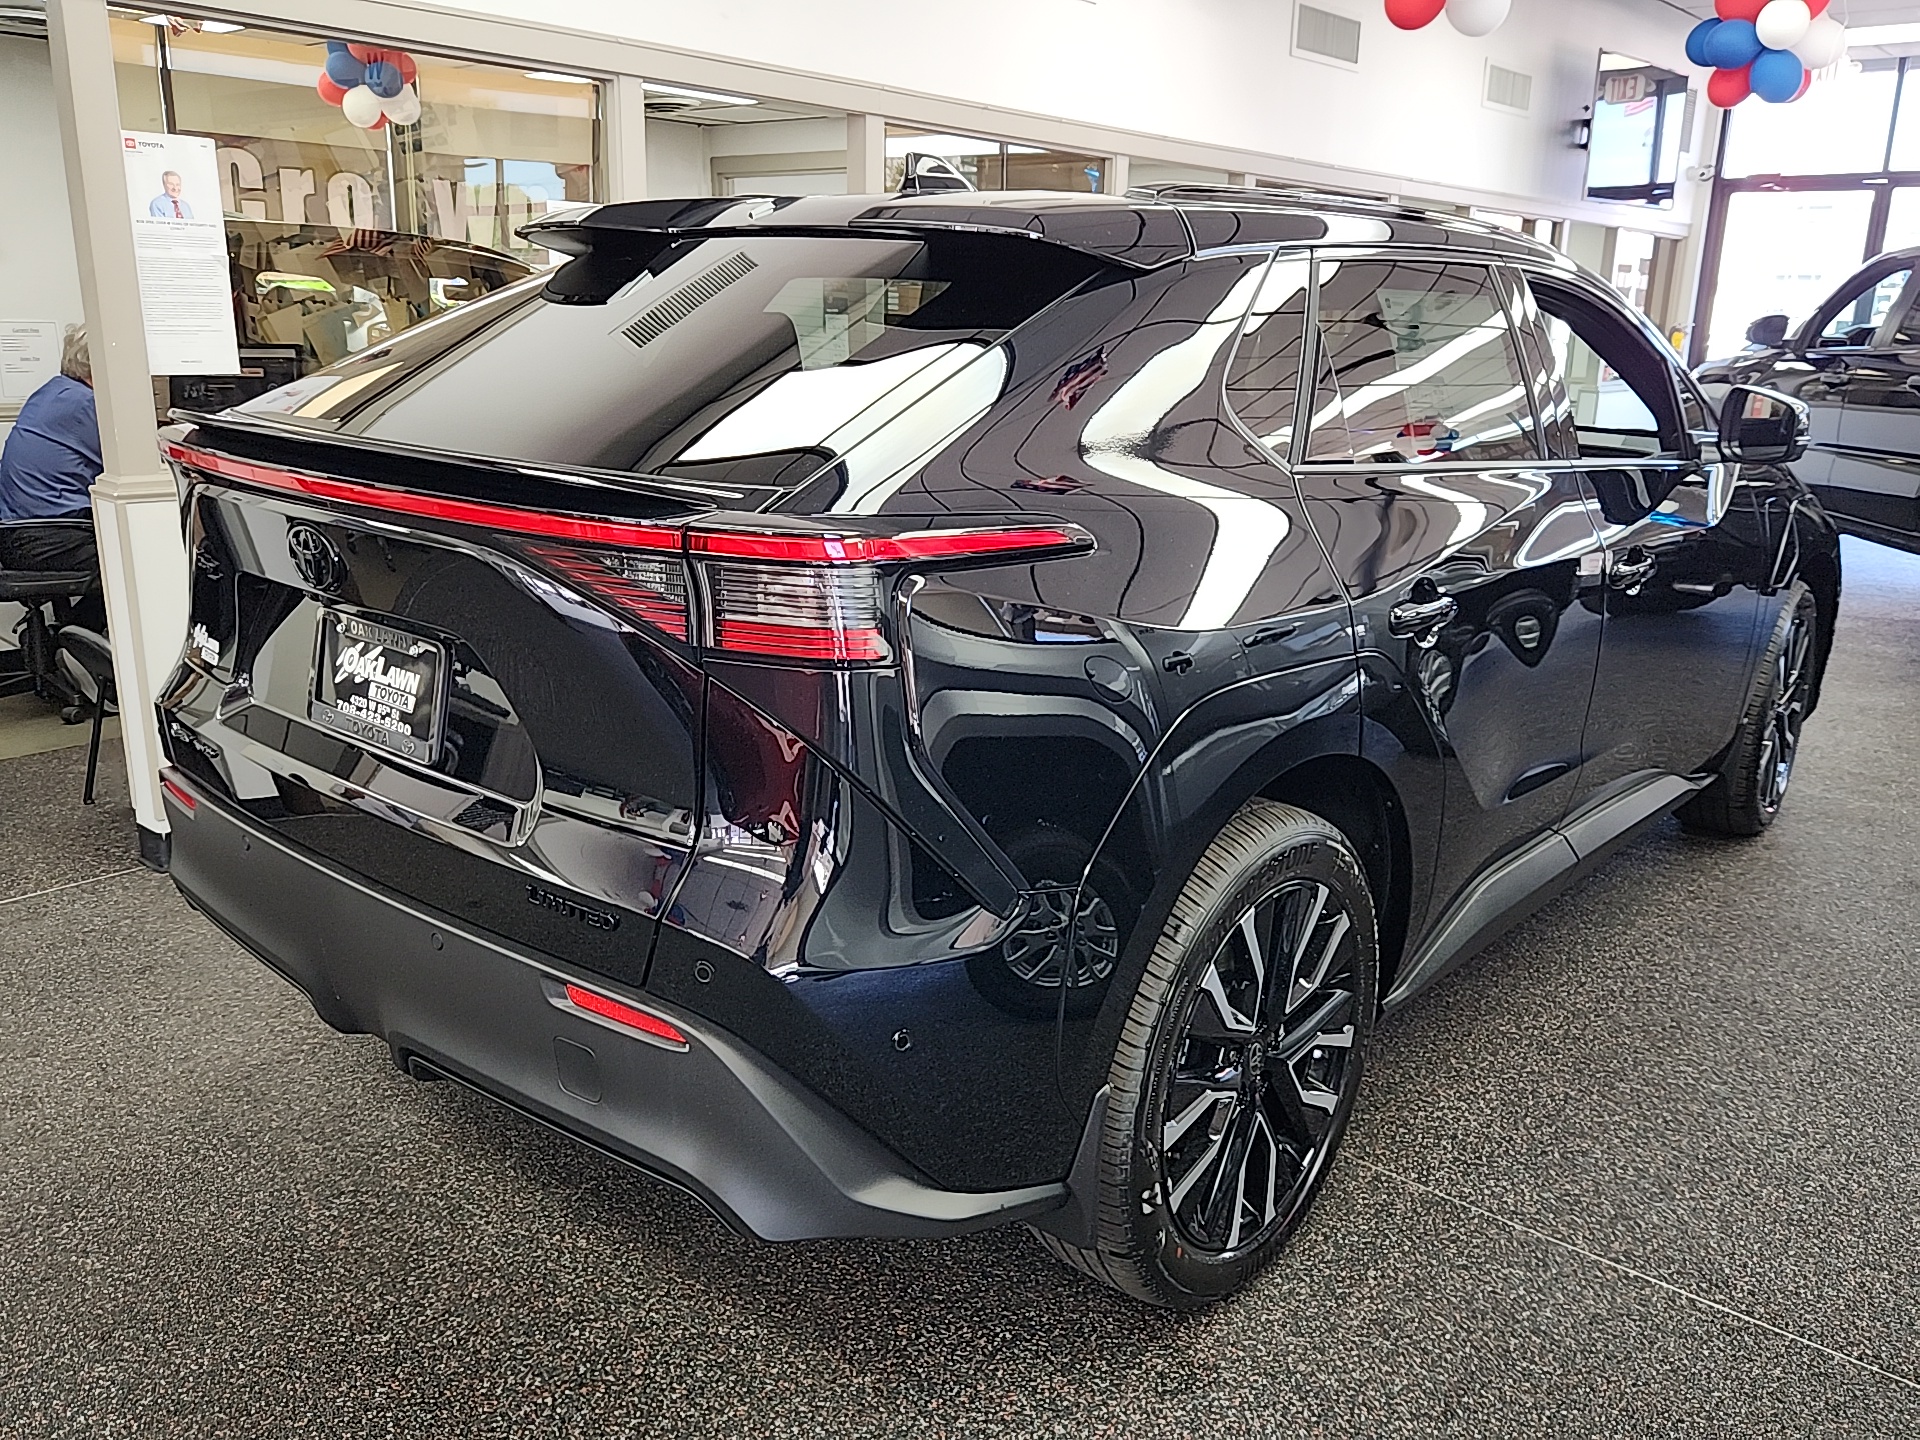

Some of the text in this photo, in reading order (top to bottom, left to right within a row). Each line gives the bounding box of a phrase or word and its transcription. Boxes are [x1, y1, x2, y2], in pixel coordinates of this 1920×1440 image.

[138, 141, 164, 149] TOYOTA
[350, 620, 409, 649] OAK LAWN
[368, 700, 377, 712] W
[374, 684, 409, 709] TOYOTA
[336, 699, 412, 736] 708-423-5200
[346, 716, 390, 746] TOYOTA
[525, 883, 620, 932] LIMITED
